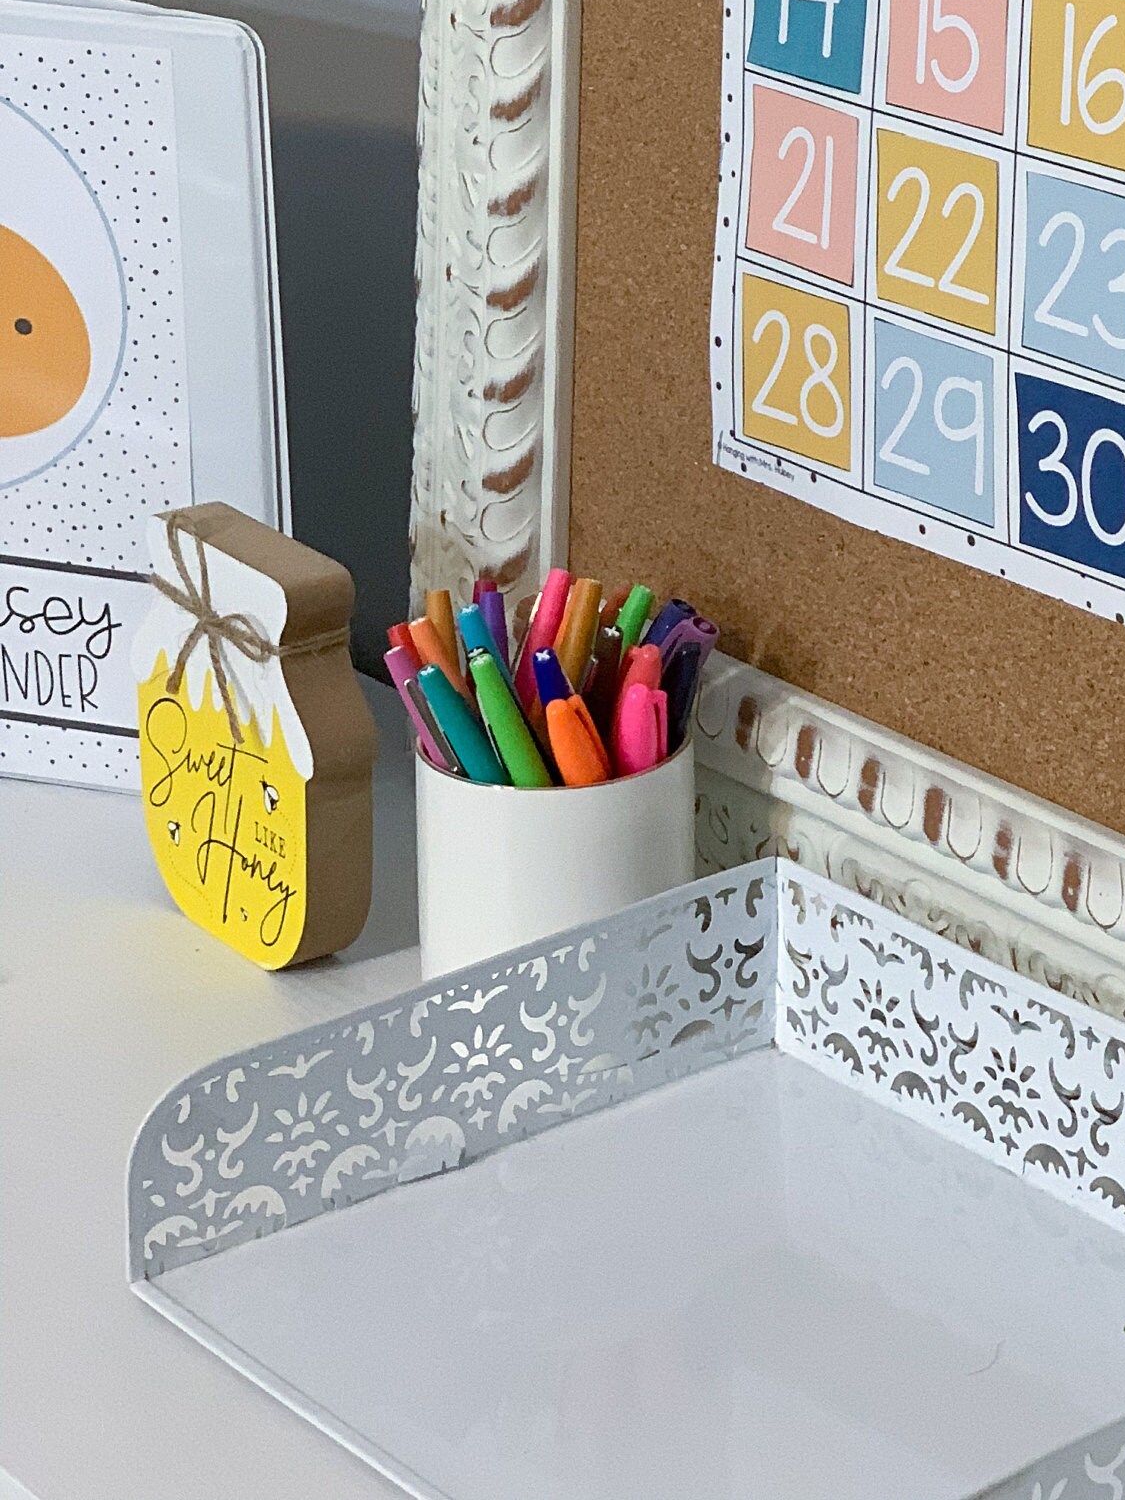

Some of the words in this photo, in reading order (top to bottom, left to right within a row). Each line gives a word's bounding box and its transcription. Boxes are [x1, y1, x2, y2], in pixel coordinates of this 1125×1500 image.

[772, 127, 833, 249] 21
[884, 167, 989, 304] 22
[752, 310, 844, 437] 28
[879, 357, 984, 495] 29
[0, 586, 122, 659] sey
[145, 697, 269, 834] Sweet
[190, 791, 297, 948] Honey
[253, 820, 287, 861] LIKE
